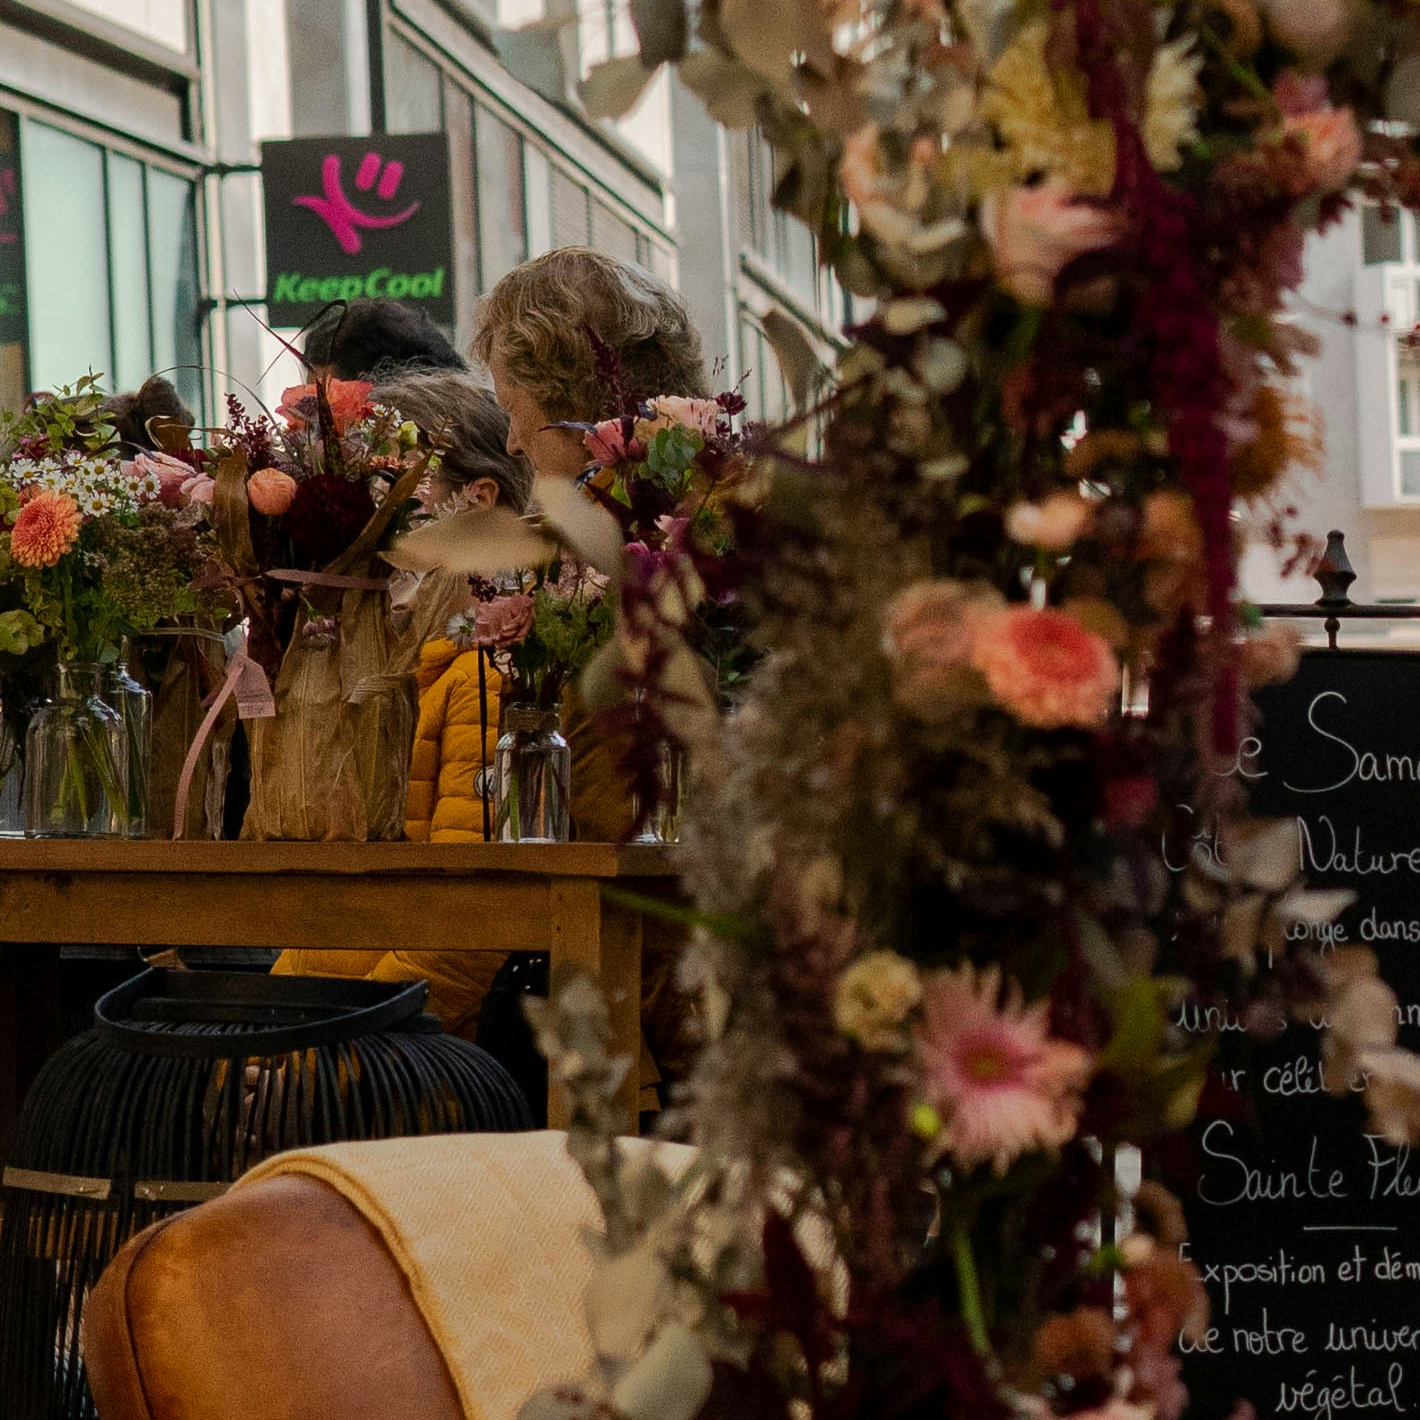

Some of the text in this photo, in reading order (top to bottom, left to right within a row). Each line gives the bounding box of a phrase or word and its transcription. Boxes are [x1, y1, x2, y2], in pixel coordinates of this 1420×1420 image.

[273, 267, 445, 302] KeepCool
[1198, 1119, 1349, 1205] Sainte
[1337, 1245, 1367, 1281] et
[1234, 1307, 1308, 1355] notre
